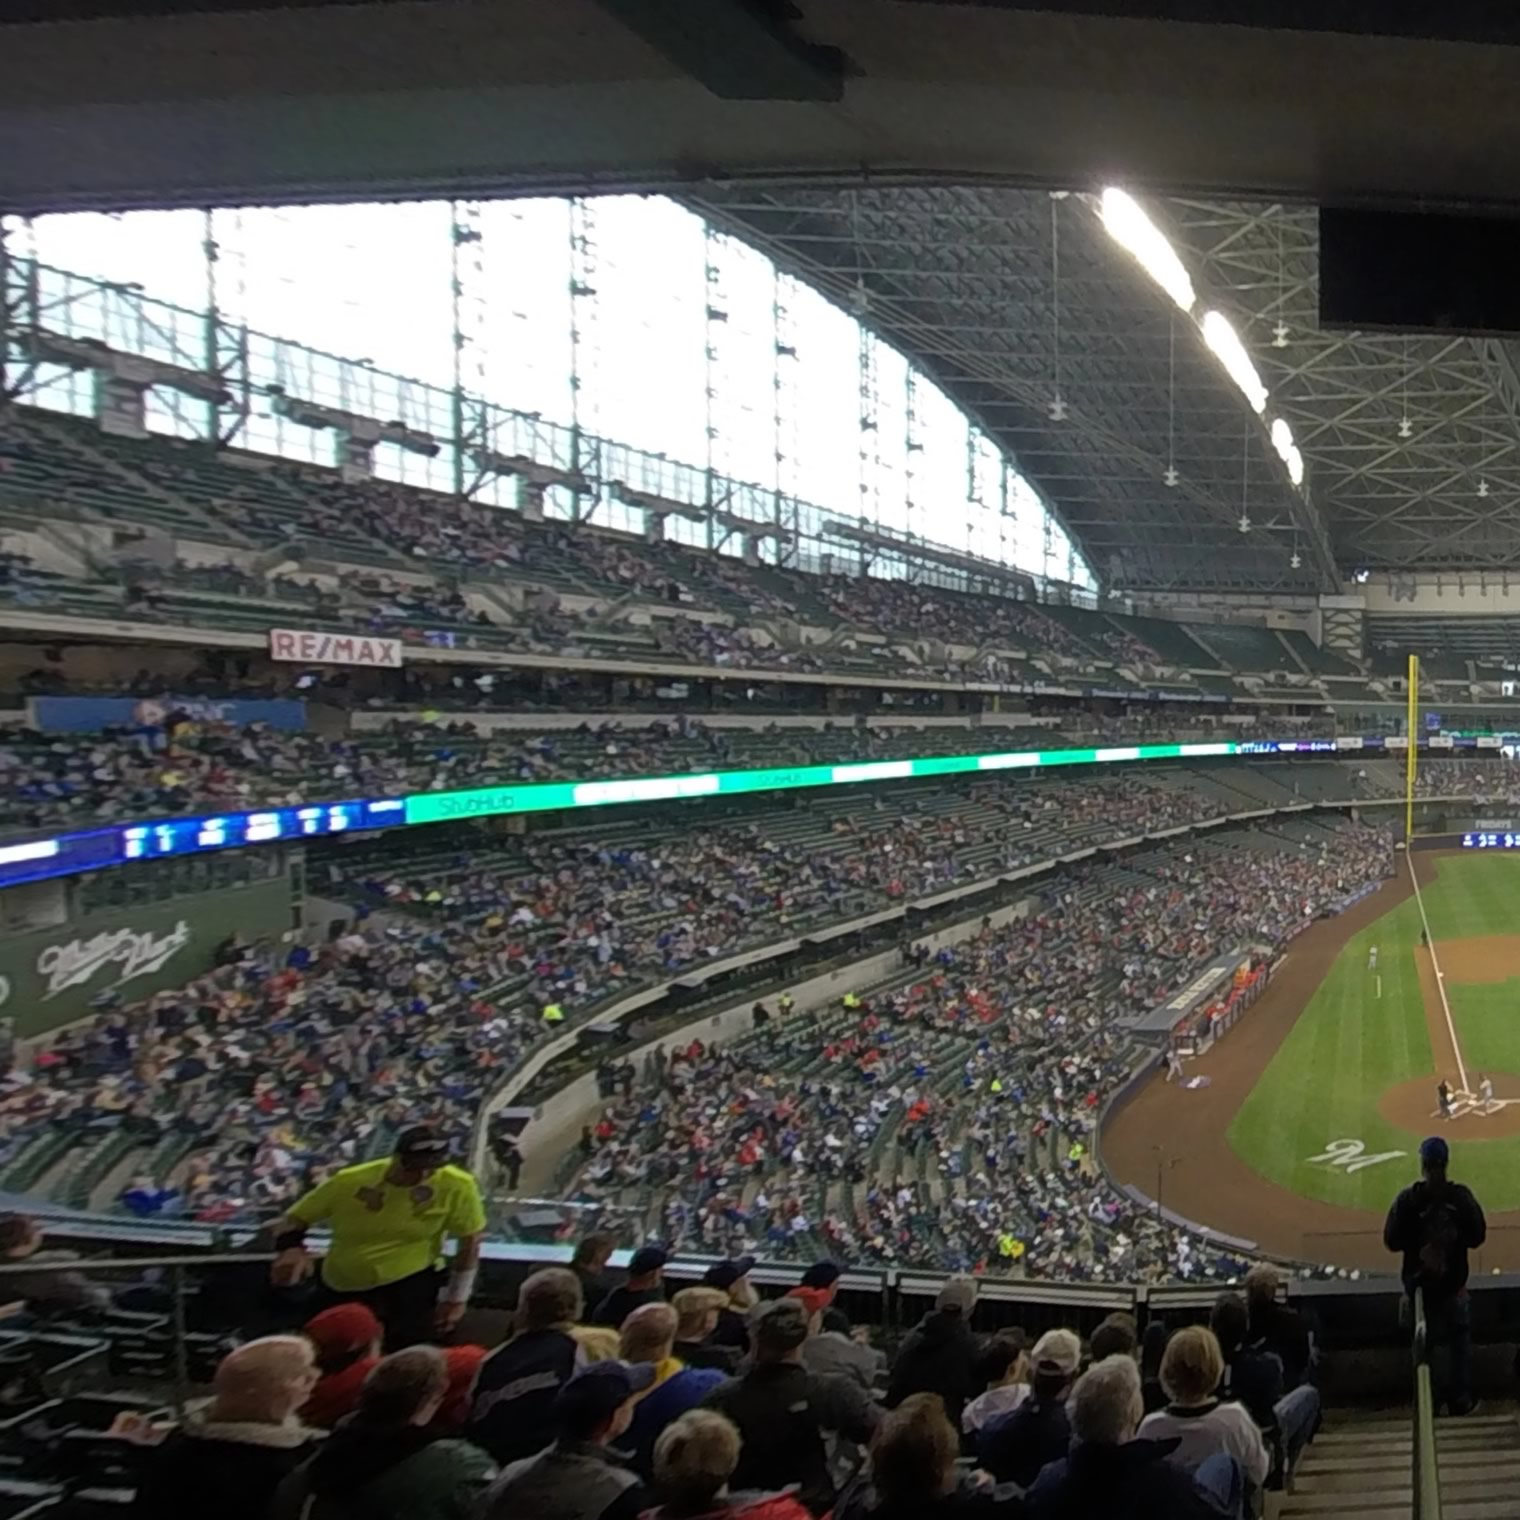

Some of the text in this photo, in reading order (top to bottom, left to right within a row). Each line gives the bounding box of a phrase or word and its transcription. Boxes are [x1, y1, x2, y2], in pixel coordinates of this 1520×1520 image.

[275, 633, 396, 664] RE/MAX
[438, 795, 515, 816] StubHub
[38, 920, 189, 1002] Miller Park
[1304, 1138, 1408, 1174] M
